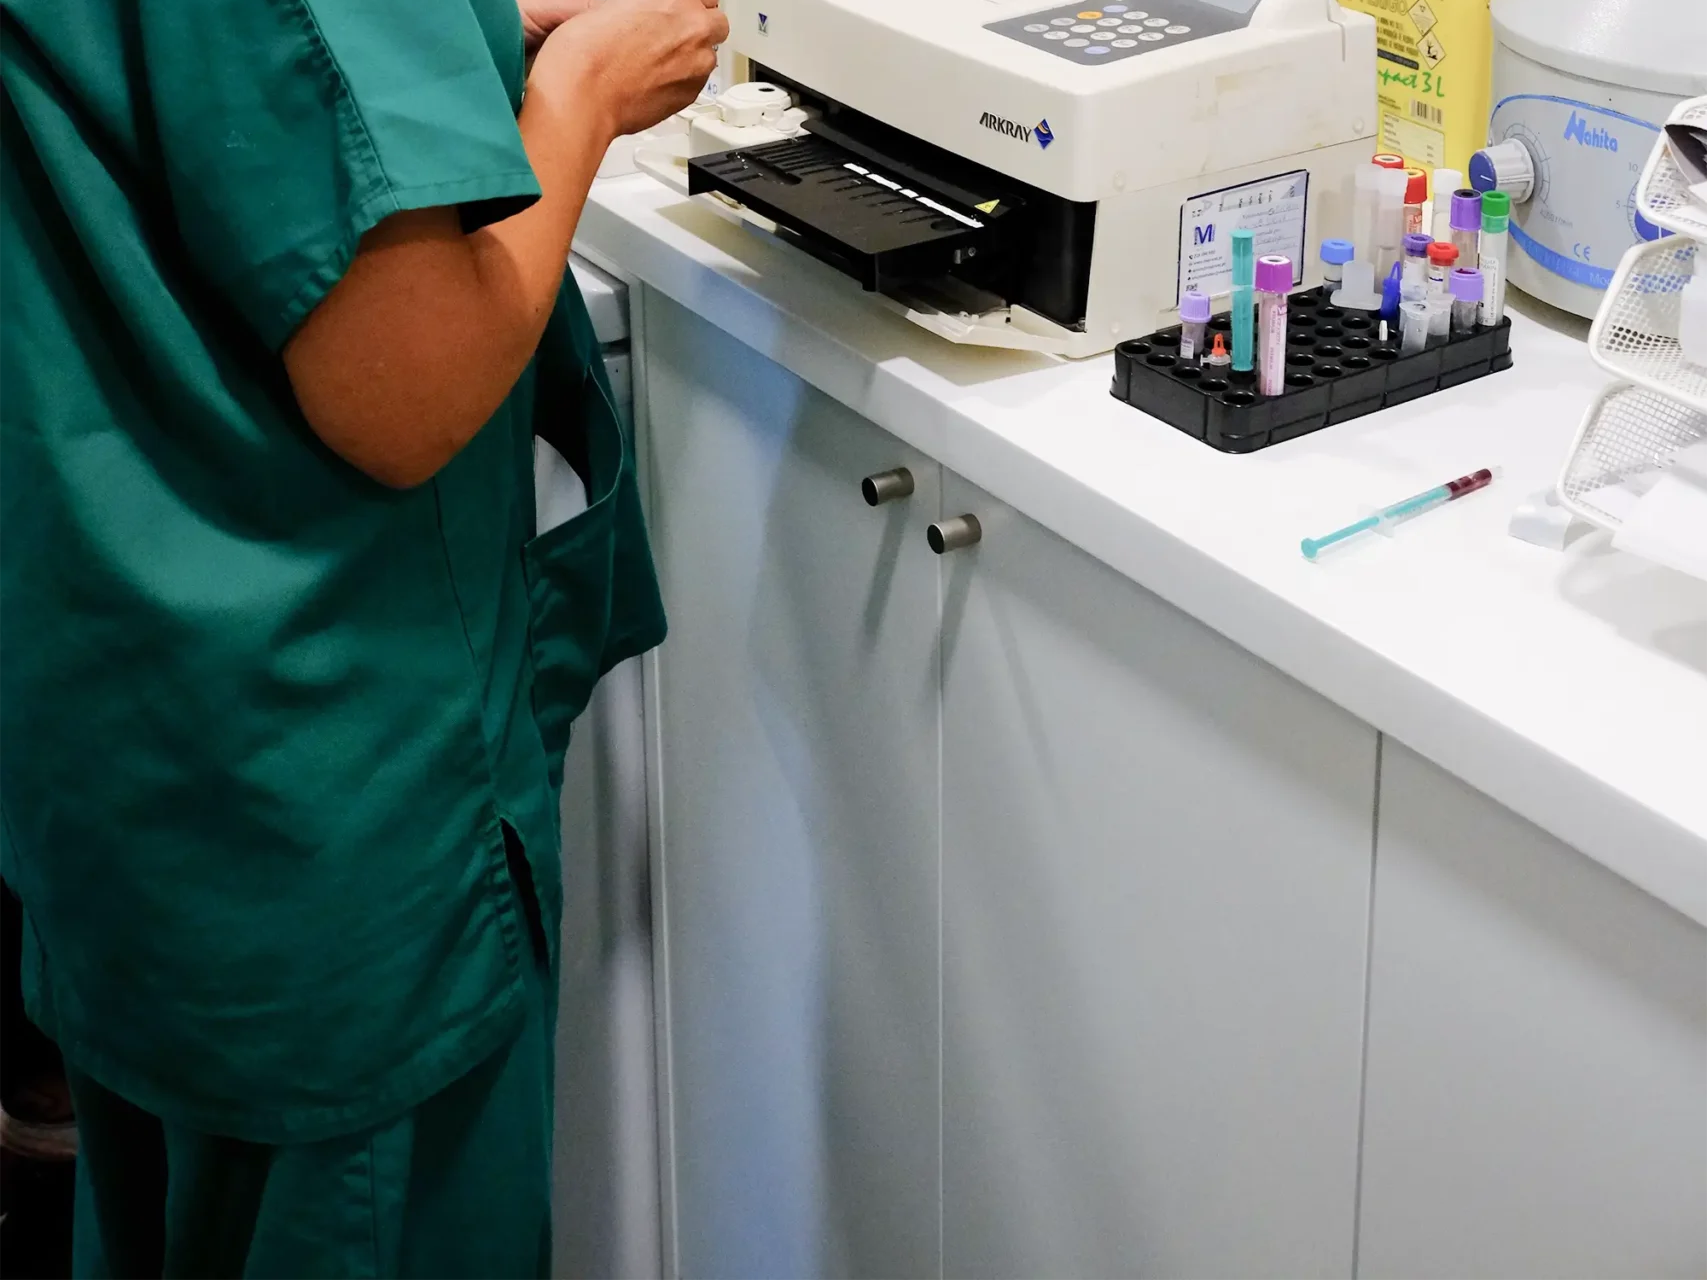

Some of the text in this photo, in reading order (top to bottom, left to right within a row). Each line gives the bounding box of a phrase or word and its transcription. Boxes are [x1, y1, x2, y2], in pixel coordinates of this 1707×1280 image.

[1422, 72, 1432, 92] 3
[1436, 76, 1445, 97] L
[979, 112, 1032, 143] ARKRAY
[1564, 110, 1618, 152] Nahita
[1628, 162, 1639, 172] 10
